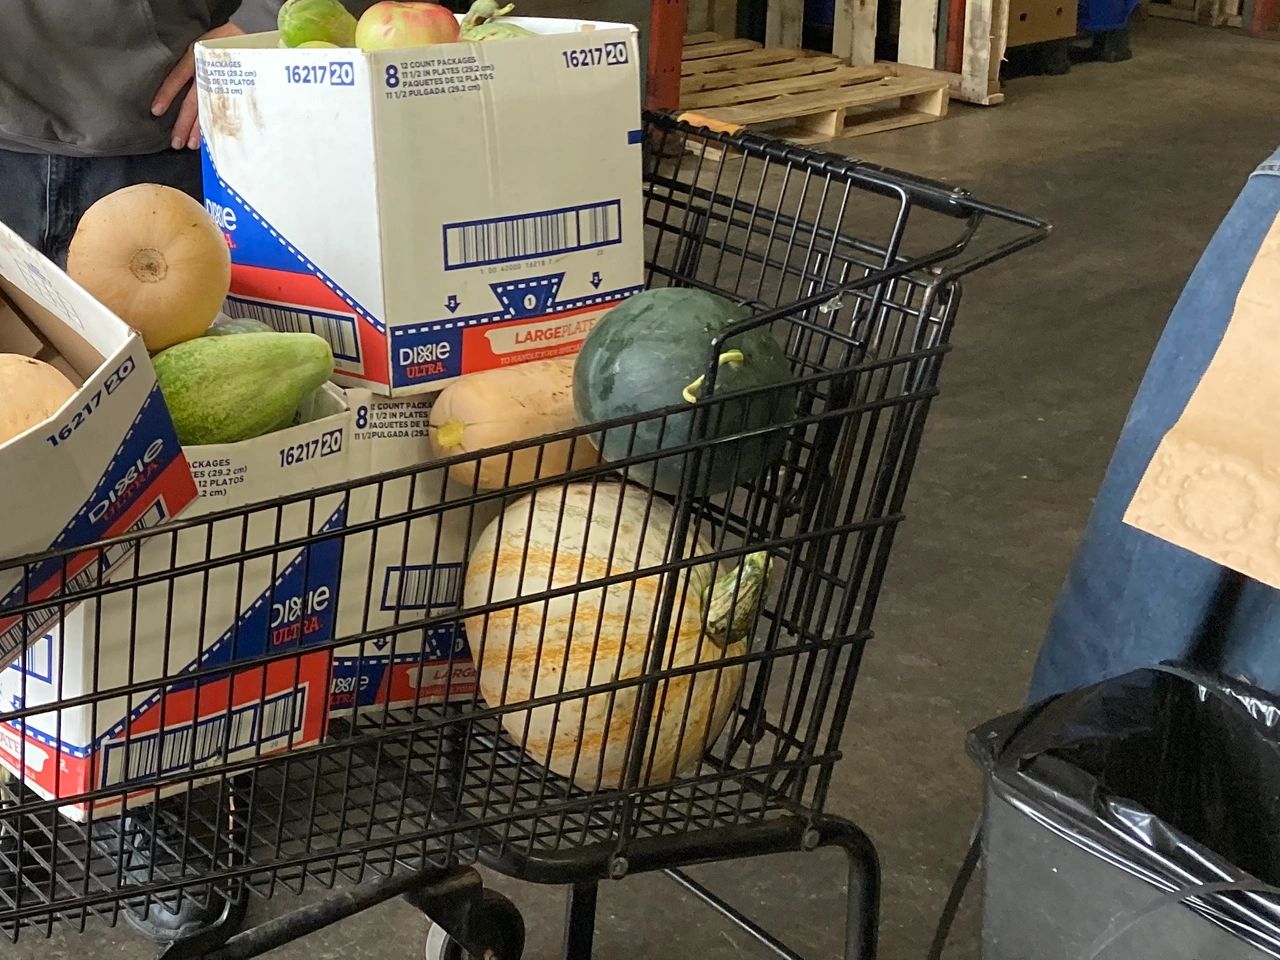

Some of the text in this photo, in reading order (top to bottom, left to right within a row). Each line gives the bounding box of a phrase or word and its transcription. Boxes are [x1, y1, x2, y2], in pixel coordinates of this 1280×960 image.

[400, 56, 477, 69] 12 COUNT PACKAGES
[562, 42, 628, 68] 16217 20
[285, 63, 353, 85] 16217 20
[385, 64, 400, 89] 8
[410, 70, 421, 79] 1/2
[423, 69, 431, 77] IN
[433, 66, 461, 76] PLATES
[461, 65, 480, 74] (29.2
[481, 64, 495, 72] cm)
[402, 73, 494, 88] PAQUETES DE 12 PLATOS
[394, 90, 407, 99] 1/2
[408, 86, 446, 98] PULGADA
[447, 84, 466, 94] (29.2
[467, 83, 481, 92] cm)
[406, 362, 445, 378] ULTRA
[47, 356, 135, 447] 16217 20
[377, 402, 404, 411] COUNT
[356, 405, 368, 429] 8
[389, 411, 397, 419] IN
[399, 410, 428, 419] PLATES
[410, 420, 420, 428] DE
[371, 430, 409, 439] PULGADA
[280, 429, 342, 468] 16217 20
[208, 465, 248, 478] (29.2 cm)
[199, 475, 245, 488] 12 PLATOS
[210, 489, 227, 498] cm)
